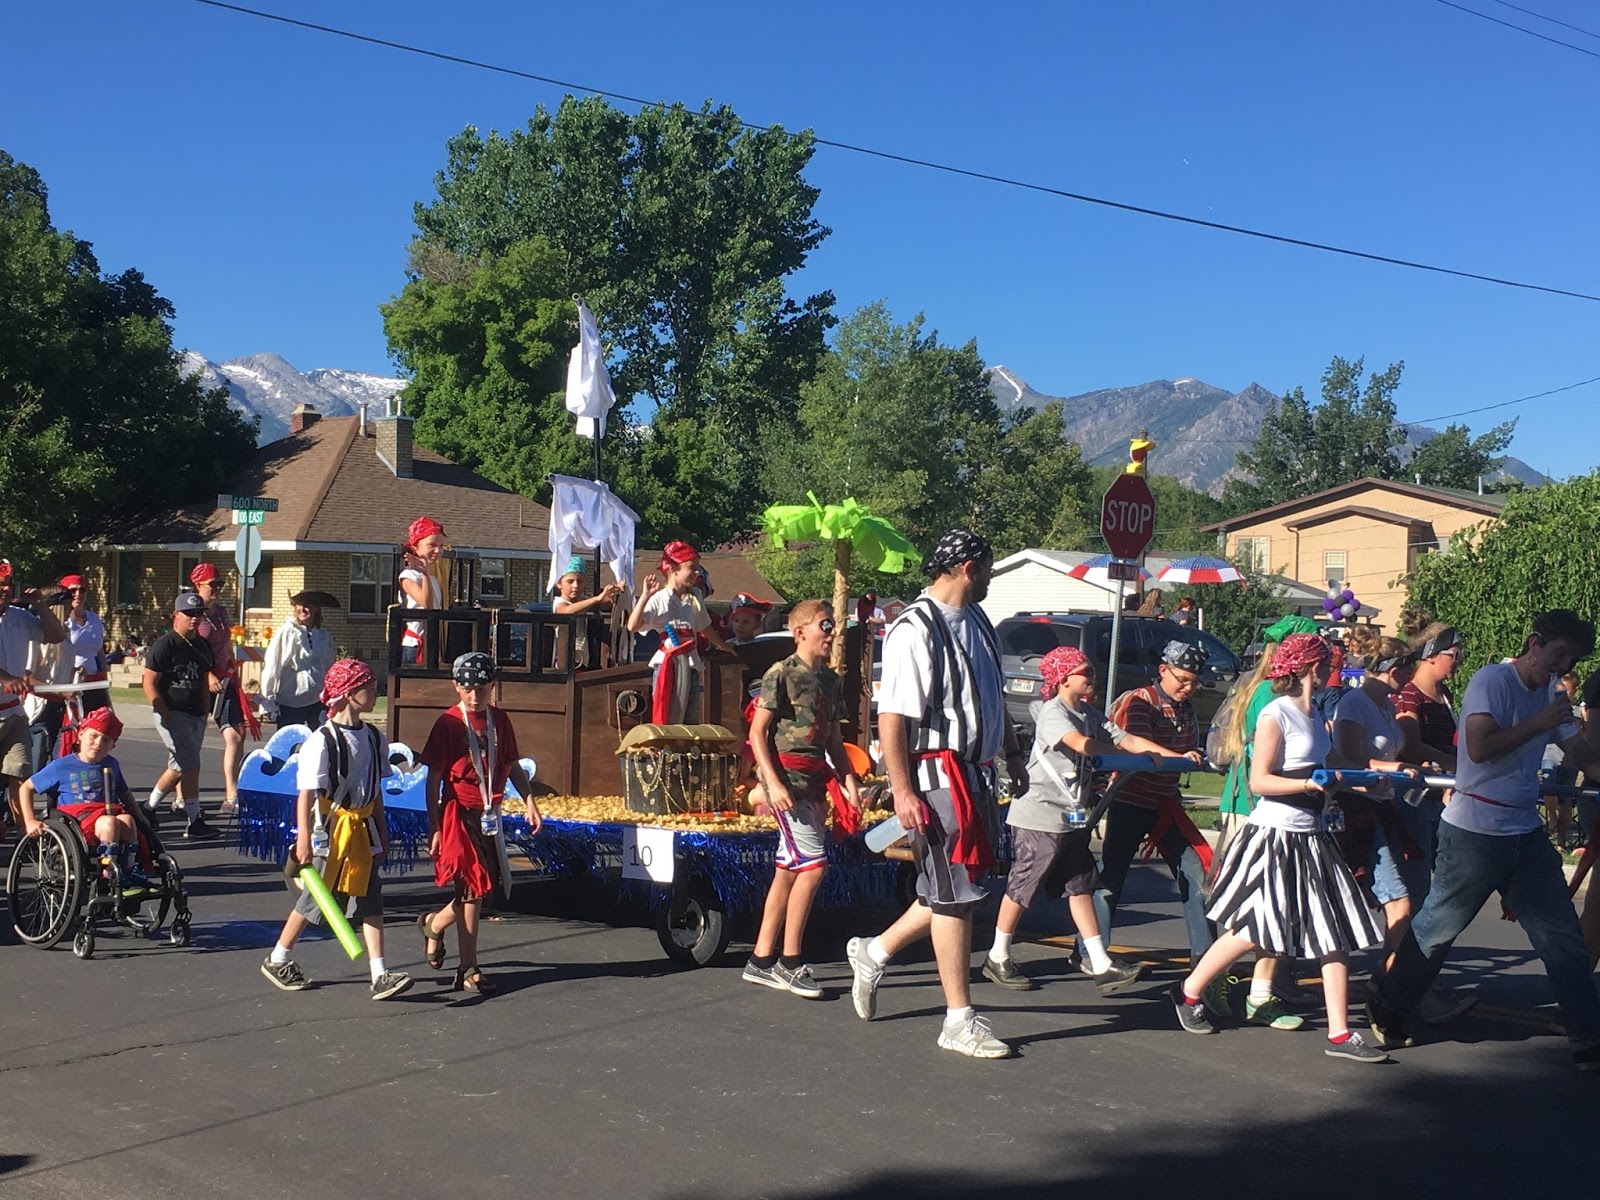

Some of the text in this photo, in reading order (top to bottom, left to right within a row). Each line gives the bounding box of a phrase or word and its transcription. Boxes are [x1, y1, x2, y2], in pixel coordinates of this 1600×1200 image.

[233, 497, 250, 509] 600
[252, 498, 278, 511] NORTH
[248, 510, 264, 524] EAST
[1105, 499, 1152, 534] STOP
[629, 844, 653, 867] 10
